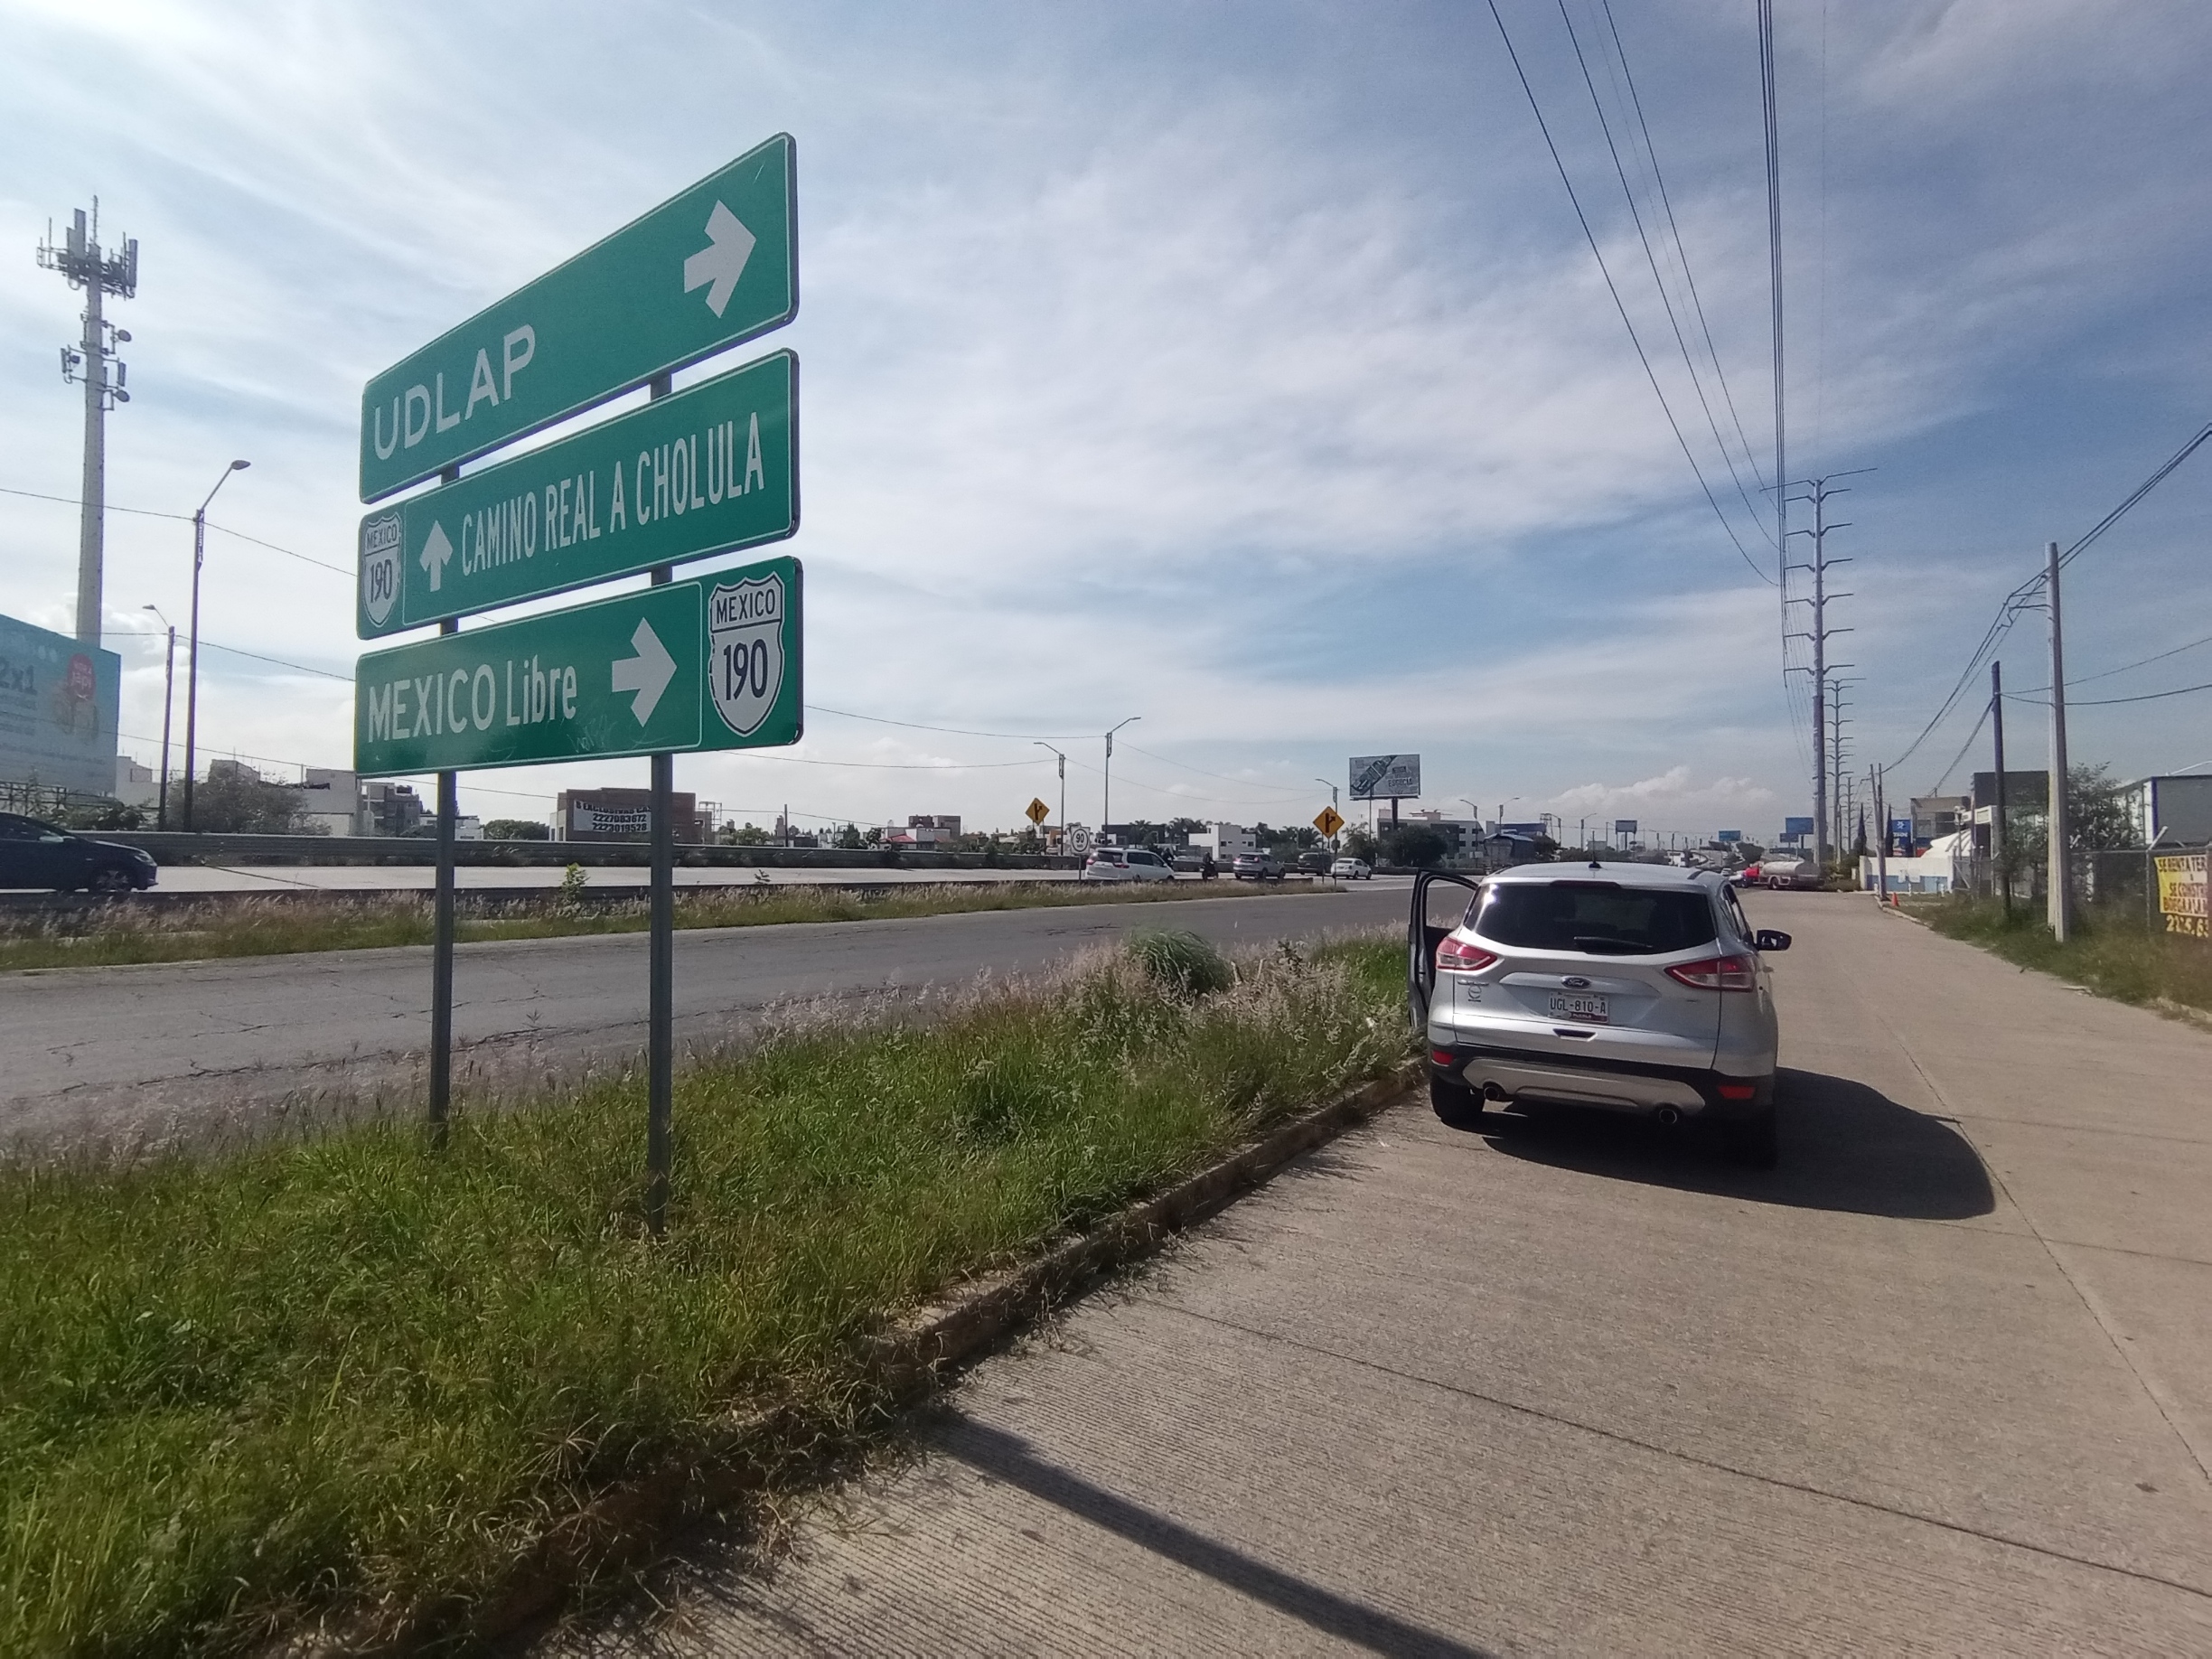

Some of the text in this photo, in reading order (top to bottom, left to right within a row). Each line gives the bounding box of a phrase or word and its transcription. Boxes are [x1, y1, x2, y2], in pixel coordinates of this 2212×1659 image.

[374, 324, 535, 460] UDLAP
[462, 412, 764, 576] CAMINO REAL A CHOLULA
[367, 524, 398, 550] MEXICO
[370, 559, 392, 604] 190
[717, 588, 776, 624] MEXICO
[723, 639, 768, 701] 190
[368, 654, 577, 743] MEXICO Libre
[1075, 833, 1084, 843] 90
[1550, 998, 1607, 1014] UGL-810-A
